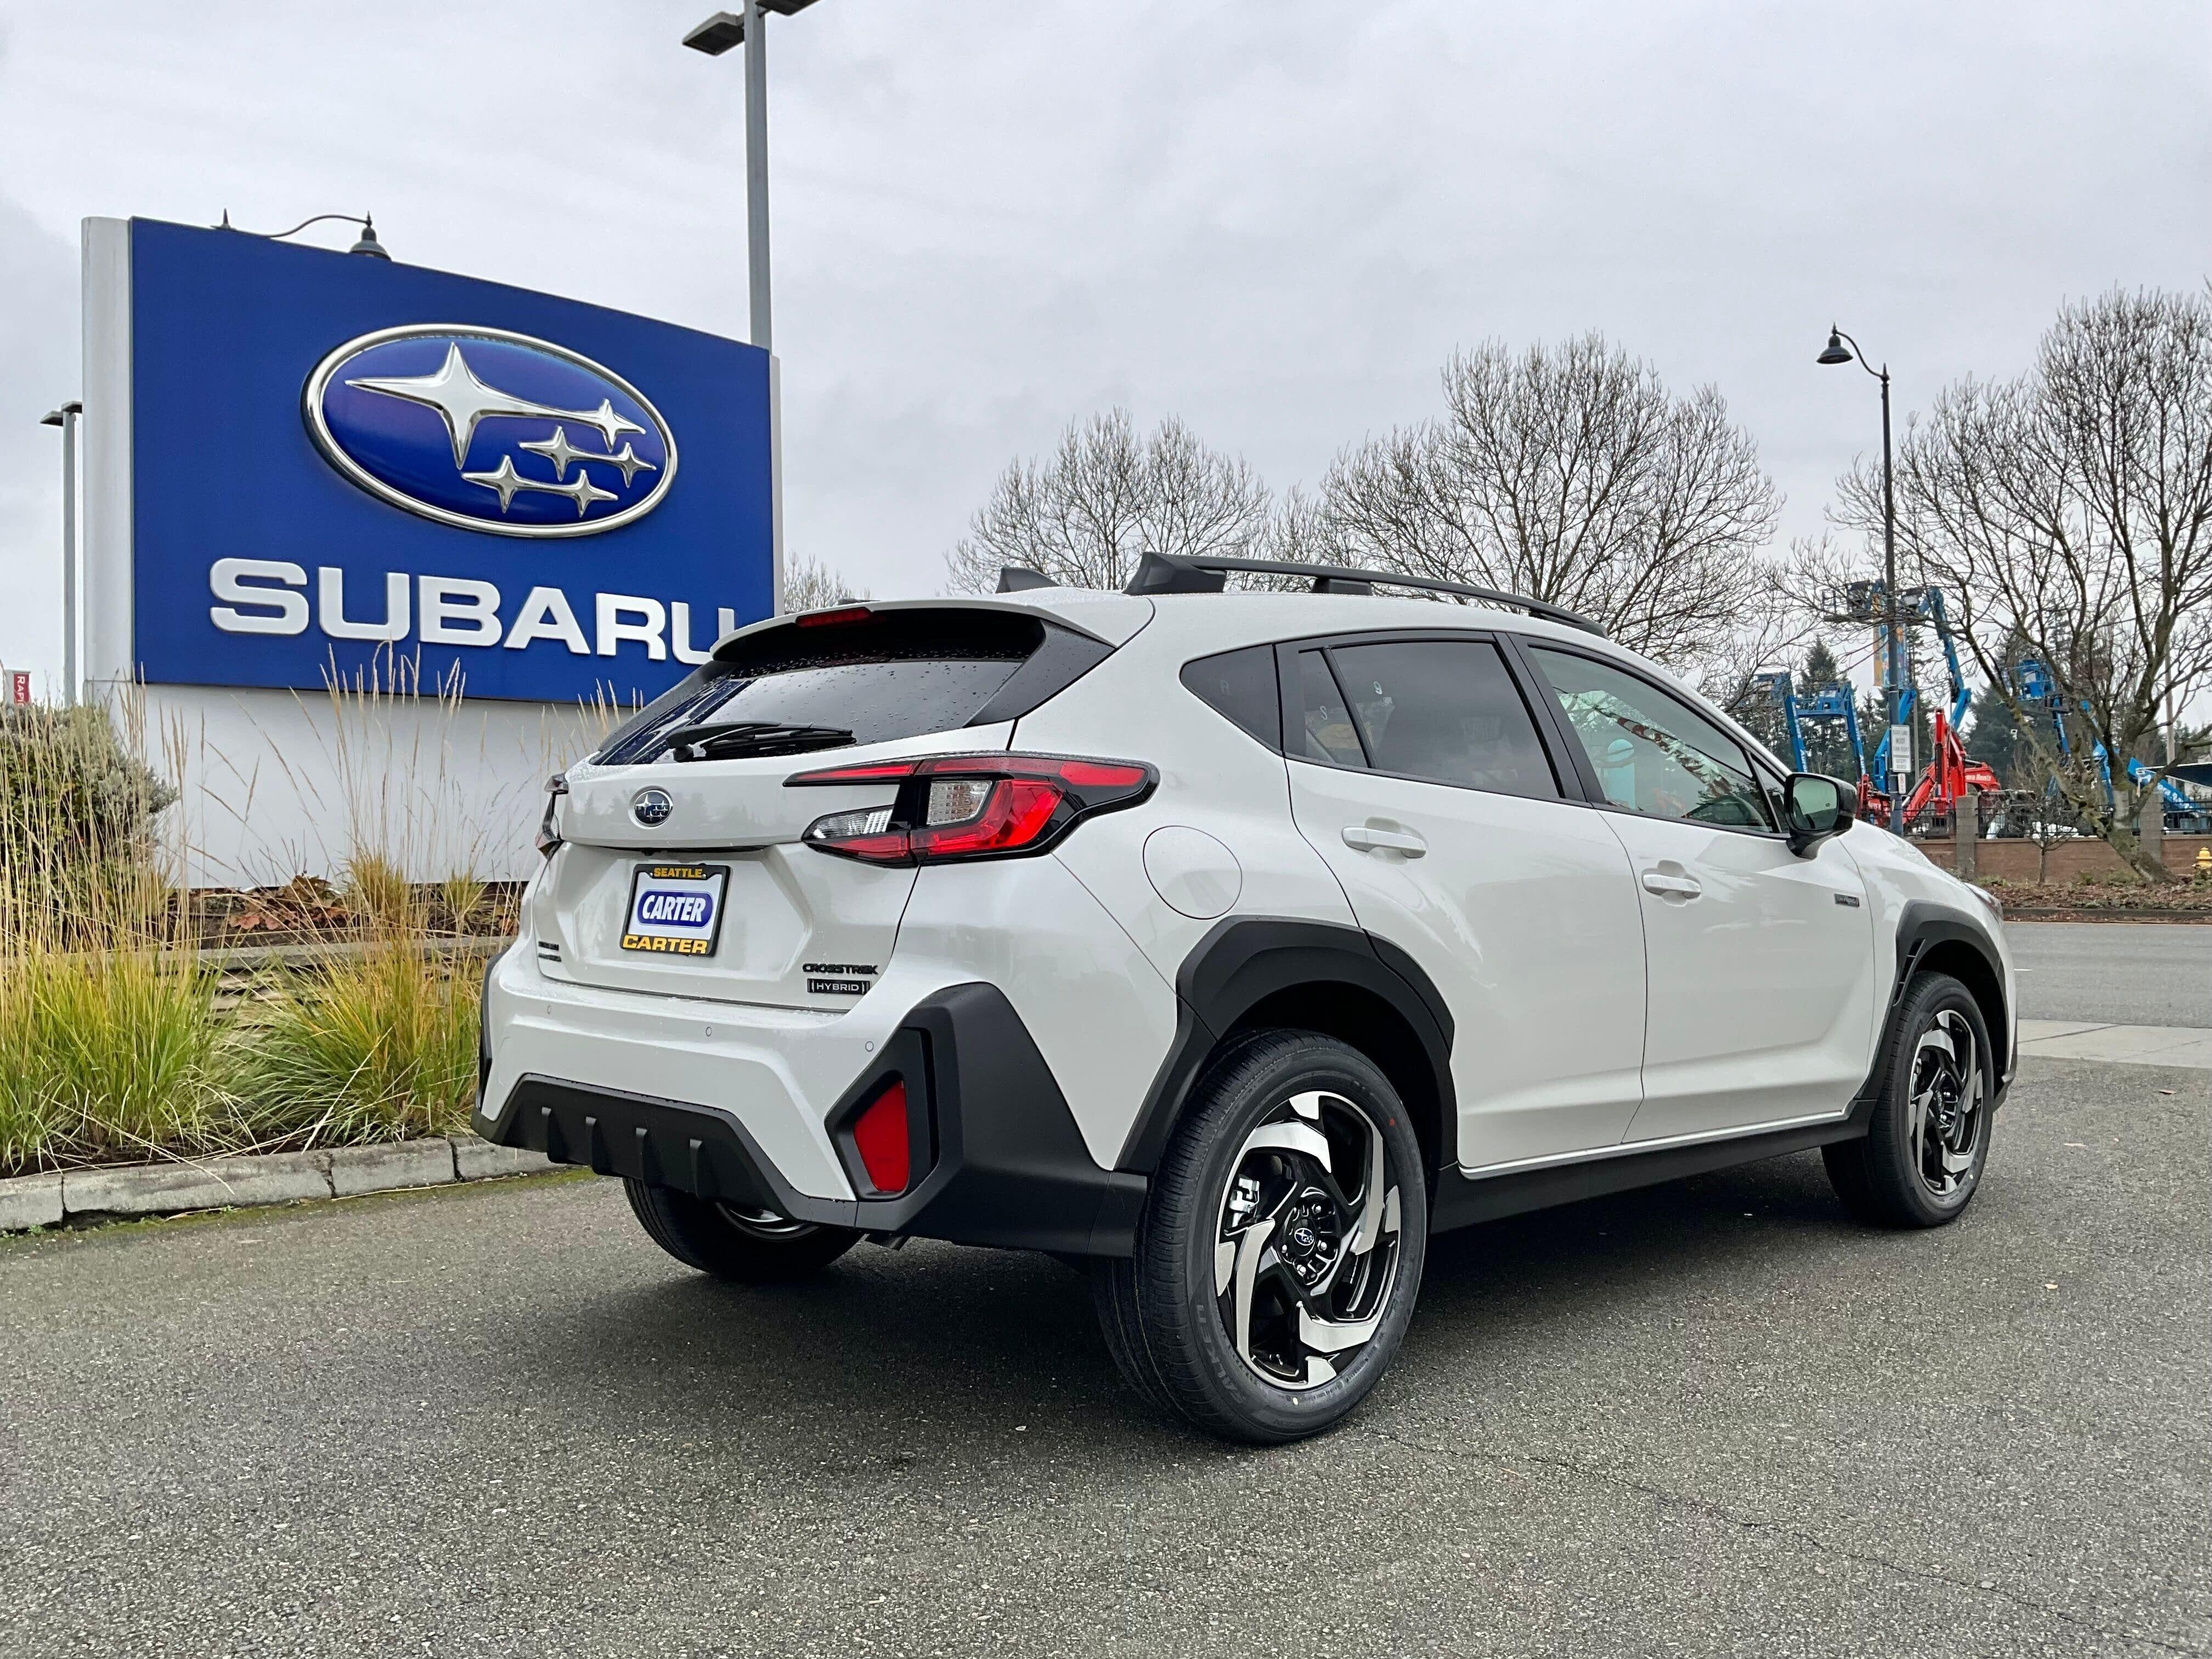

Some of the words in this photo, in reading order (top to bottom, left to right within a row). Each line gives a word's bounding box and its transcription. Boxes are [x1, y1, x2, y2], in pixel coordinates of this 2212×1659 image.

[210, 557, 735, 665] SUBARU
[653, 867, 703, 878] SEATTLE
[642, 894, 706, 922] CARTER
[622, 934, 708, 954] CARTER
[802, 963, 879, 975] CROSSTREK
[816, 983, 860, 991] HYBRID
